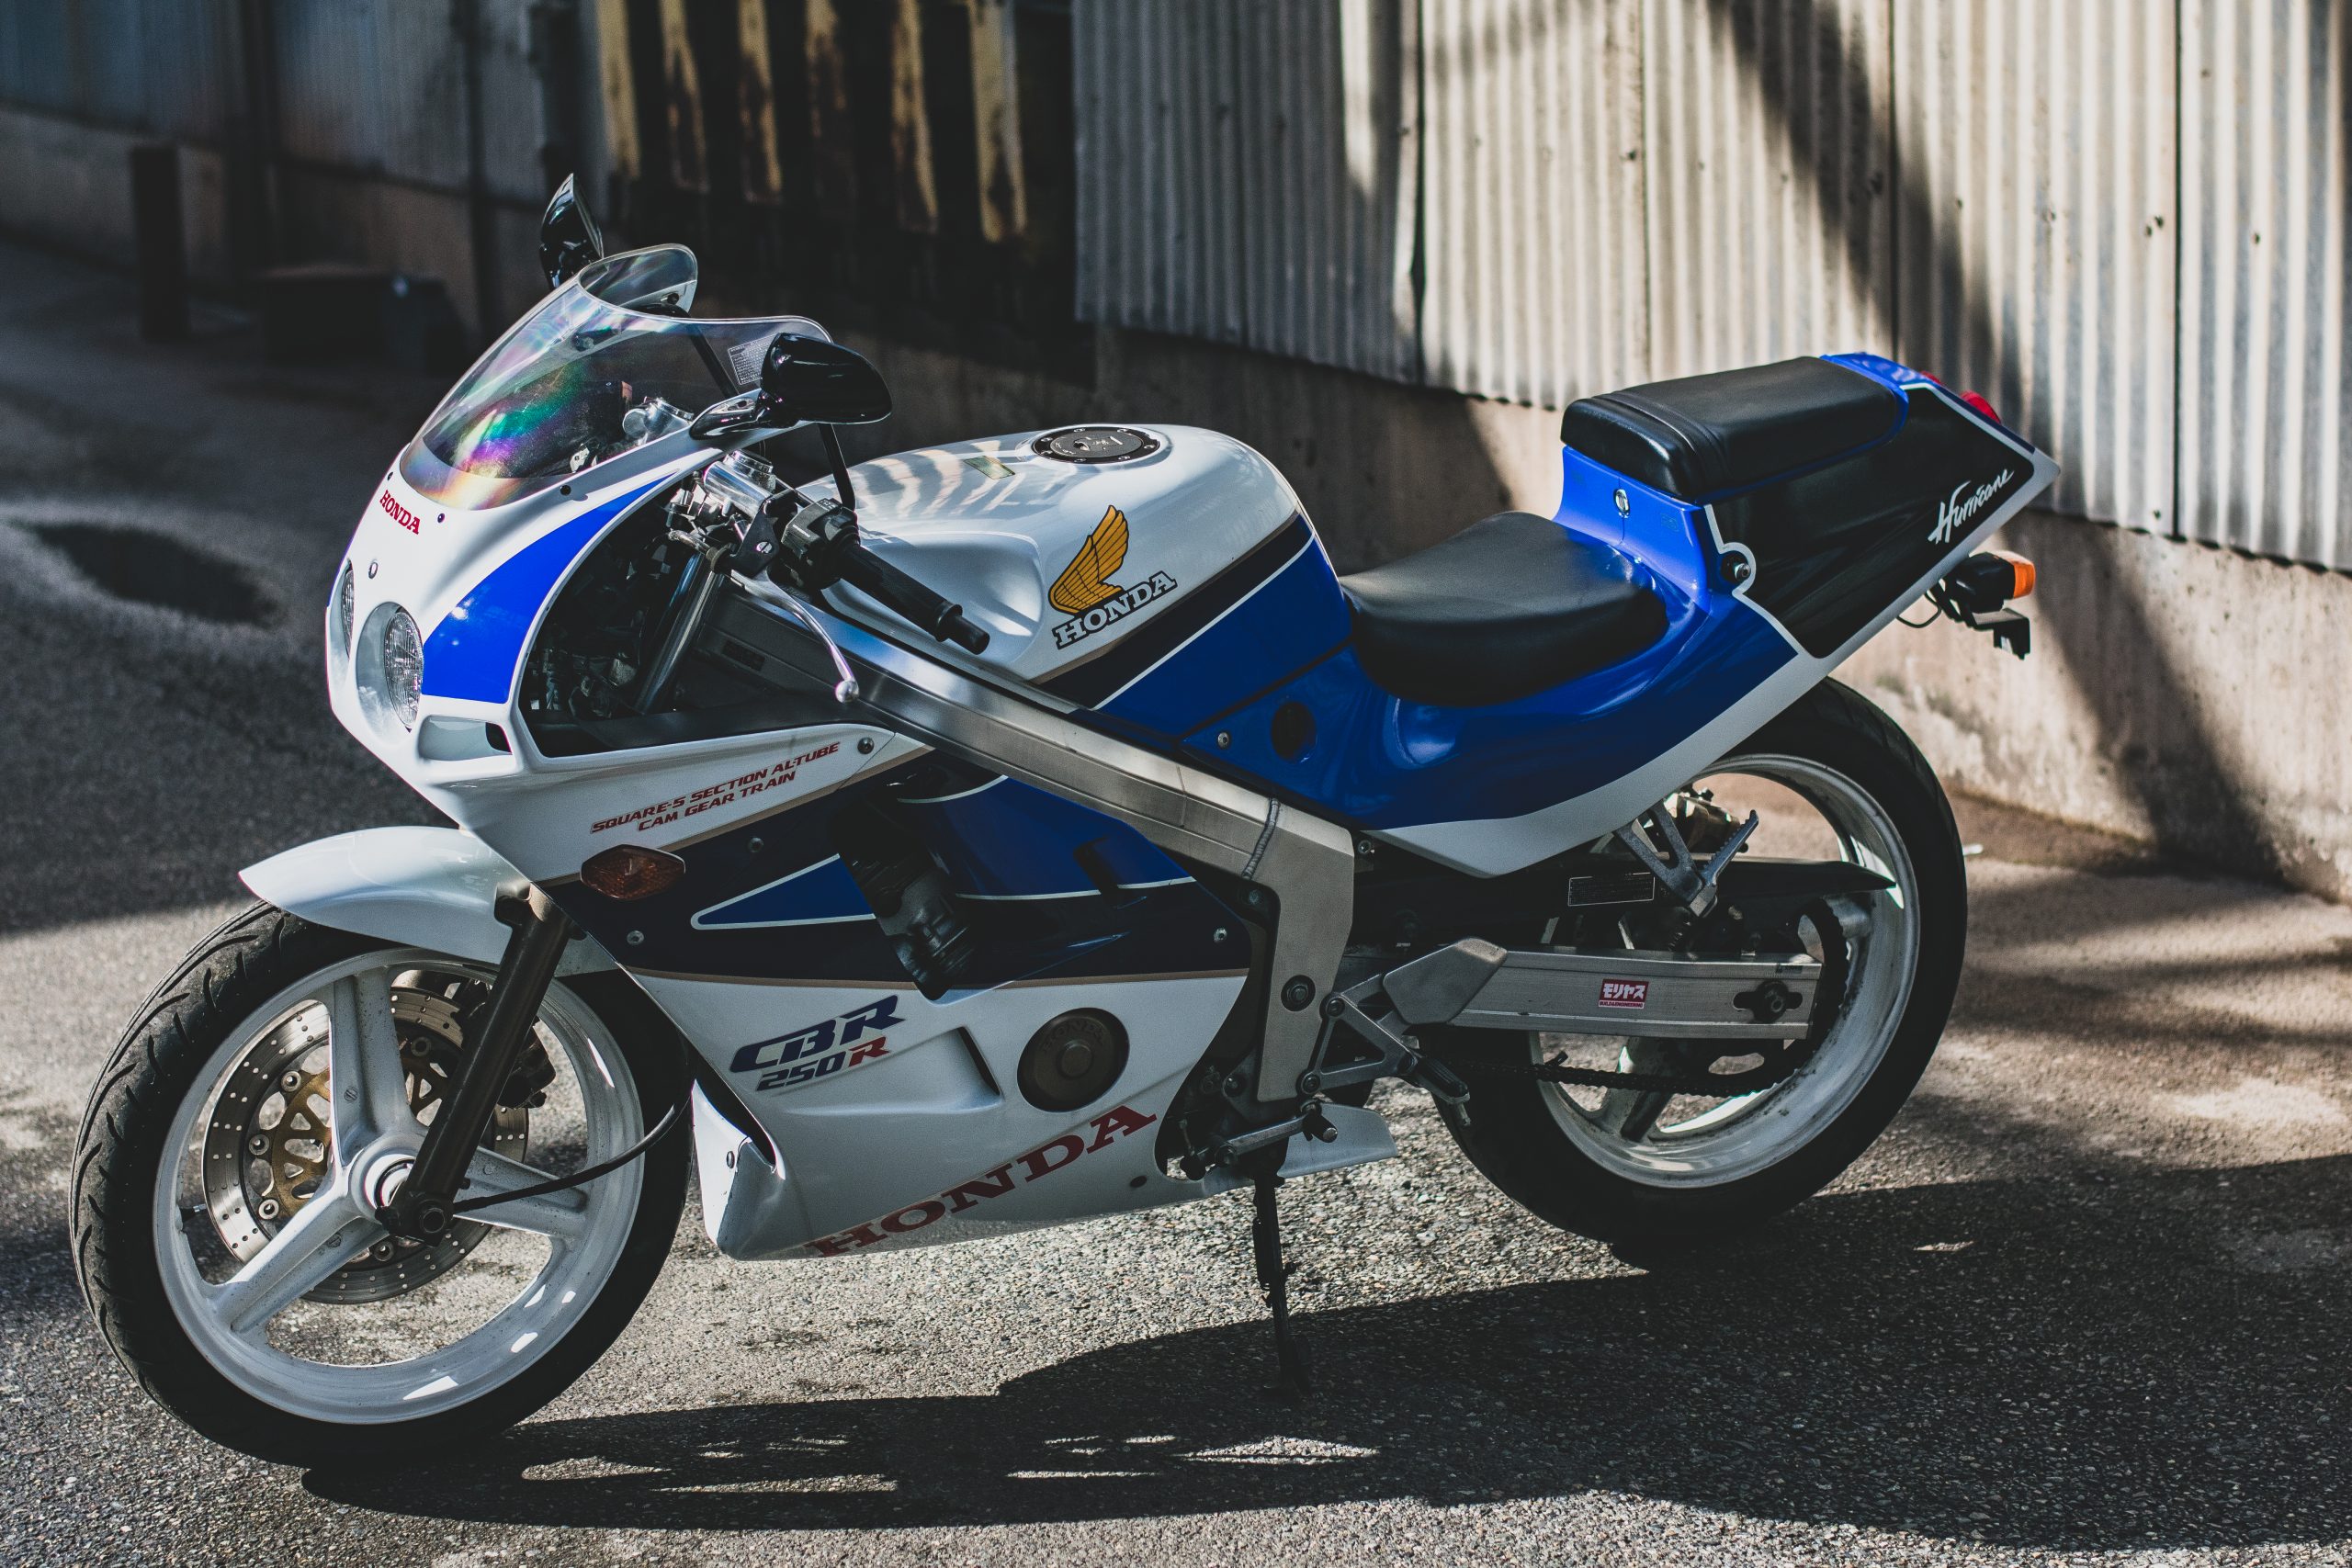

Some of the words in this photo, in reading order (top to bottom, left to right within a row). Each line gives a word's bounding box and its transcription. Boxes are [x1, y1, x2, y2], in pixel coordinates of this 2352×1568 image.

[379, 489, 421, 535] HONDA
[1928, 468, 2015, 545] Hurricane
[1053, 570, 1178, 649] HONDA
[638, 811, 679, 831] CAM
[684, 792, 736, 817] GEAR
[740, 771, 797, 798] TRAIN
[690, 768, 768, 804] SECTION
[1602, 983, 1646, 999] モリヤス
[729, 995, 905, 1073] CBR
[756, 1036, 891, 1091] 250R
[803, 1104, 1158, 1258] HONDA
